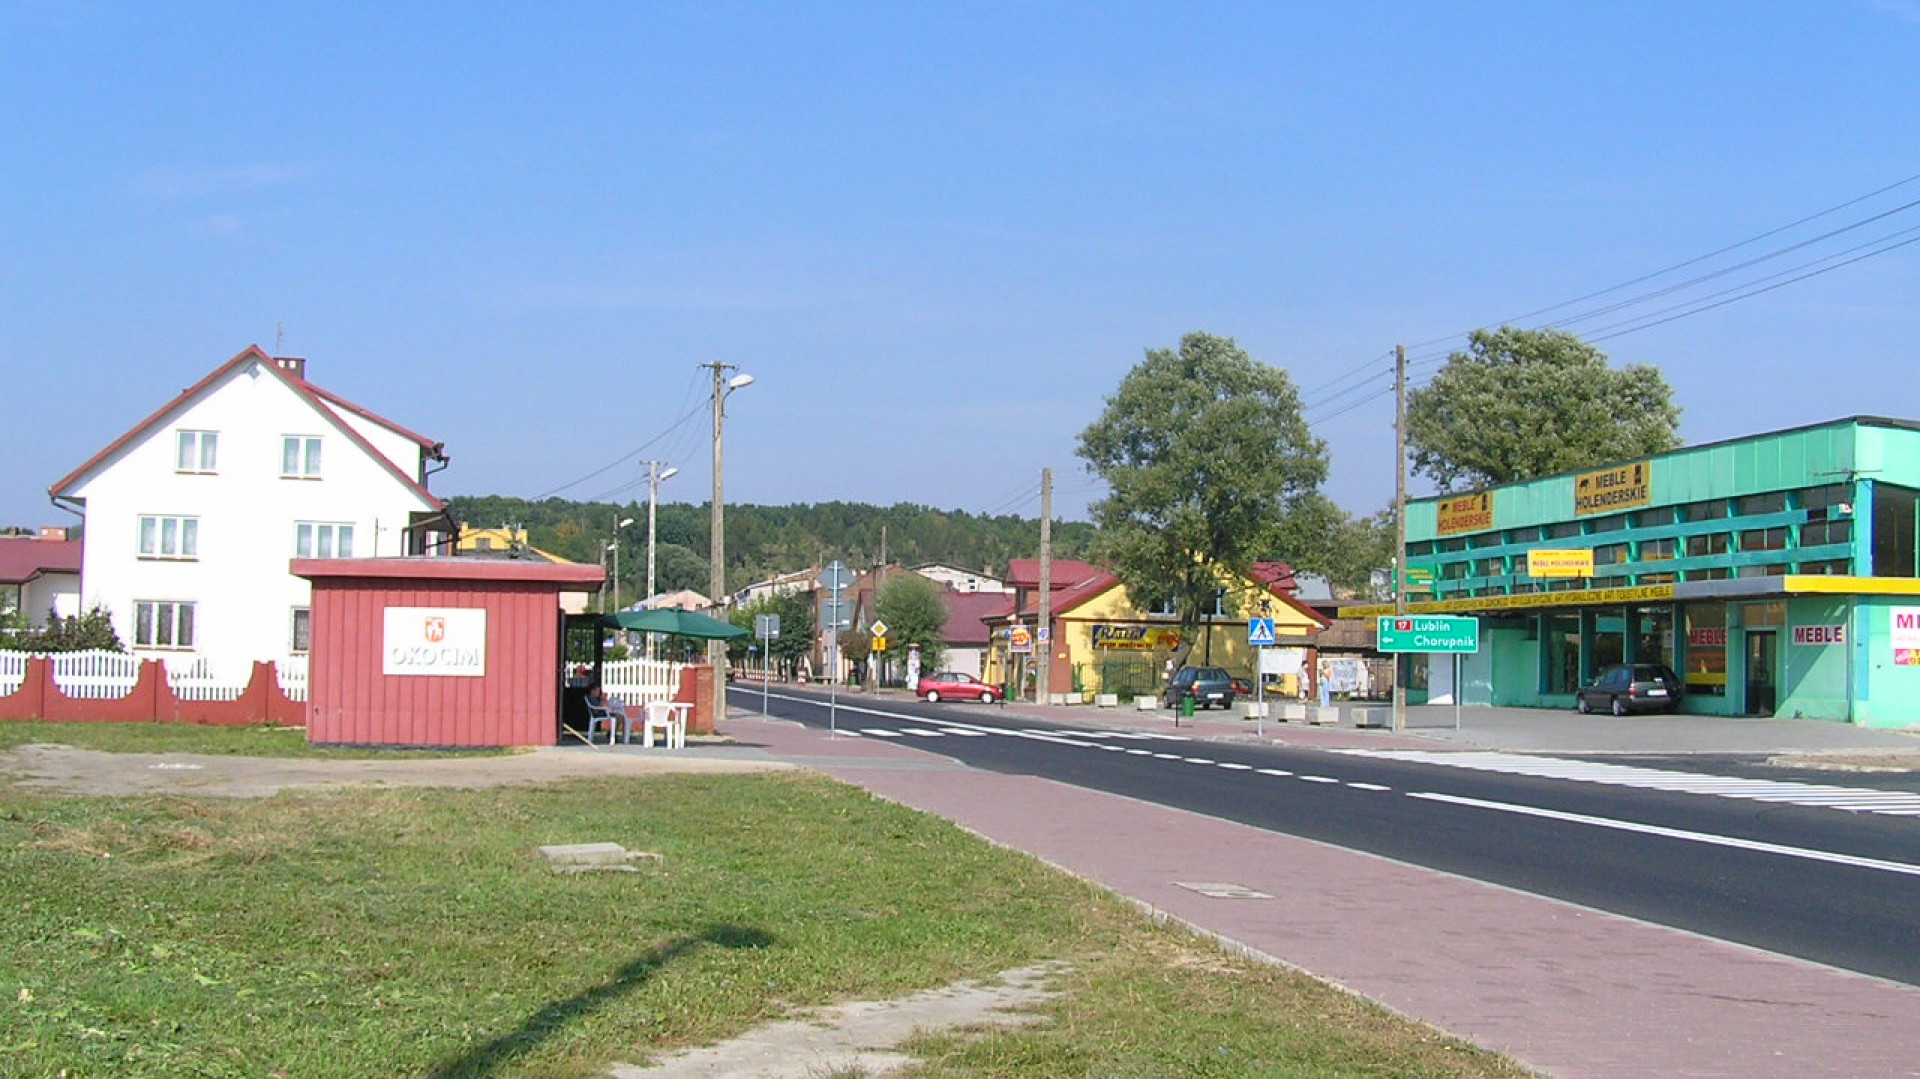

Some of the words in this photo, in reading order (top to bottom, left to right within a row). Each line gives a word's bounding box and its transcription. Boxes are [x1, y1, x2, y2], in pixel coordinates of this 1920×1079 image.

[1595, 470, 1627, 489] MEBLE
[1452, 497, 1477, 512] MEBLE
[1576, 485, 1648, 511] HOLENDERSKIE
[1438, 511, 1492, 531] HOLENDERSKIE
[1397, 620, 1407, 629] 17
[1414, 619, 1450, 631] Lublin
[1414, 635, 1474, 648] Chorupnik
[1690, 628, 1727, 645] MEBLE
[1794, 626, 1843, 642] MEBLE
[392, 647, 480, 666] OKOCIM
